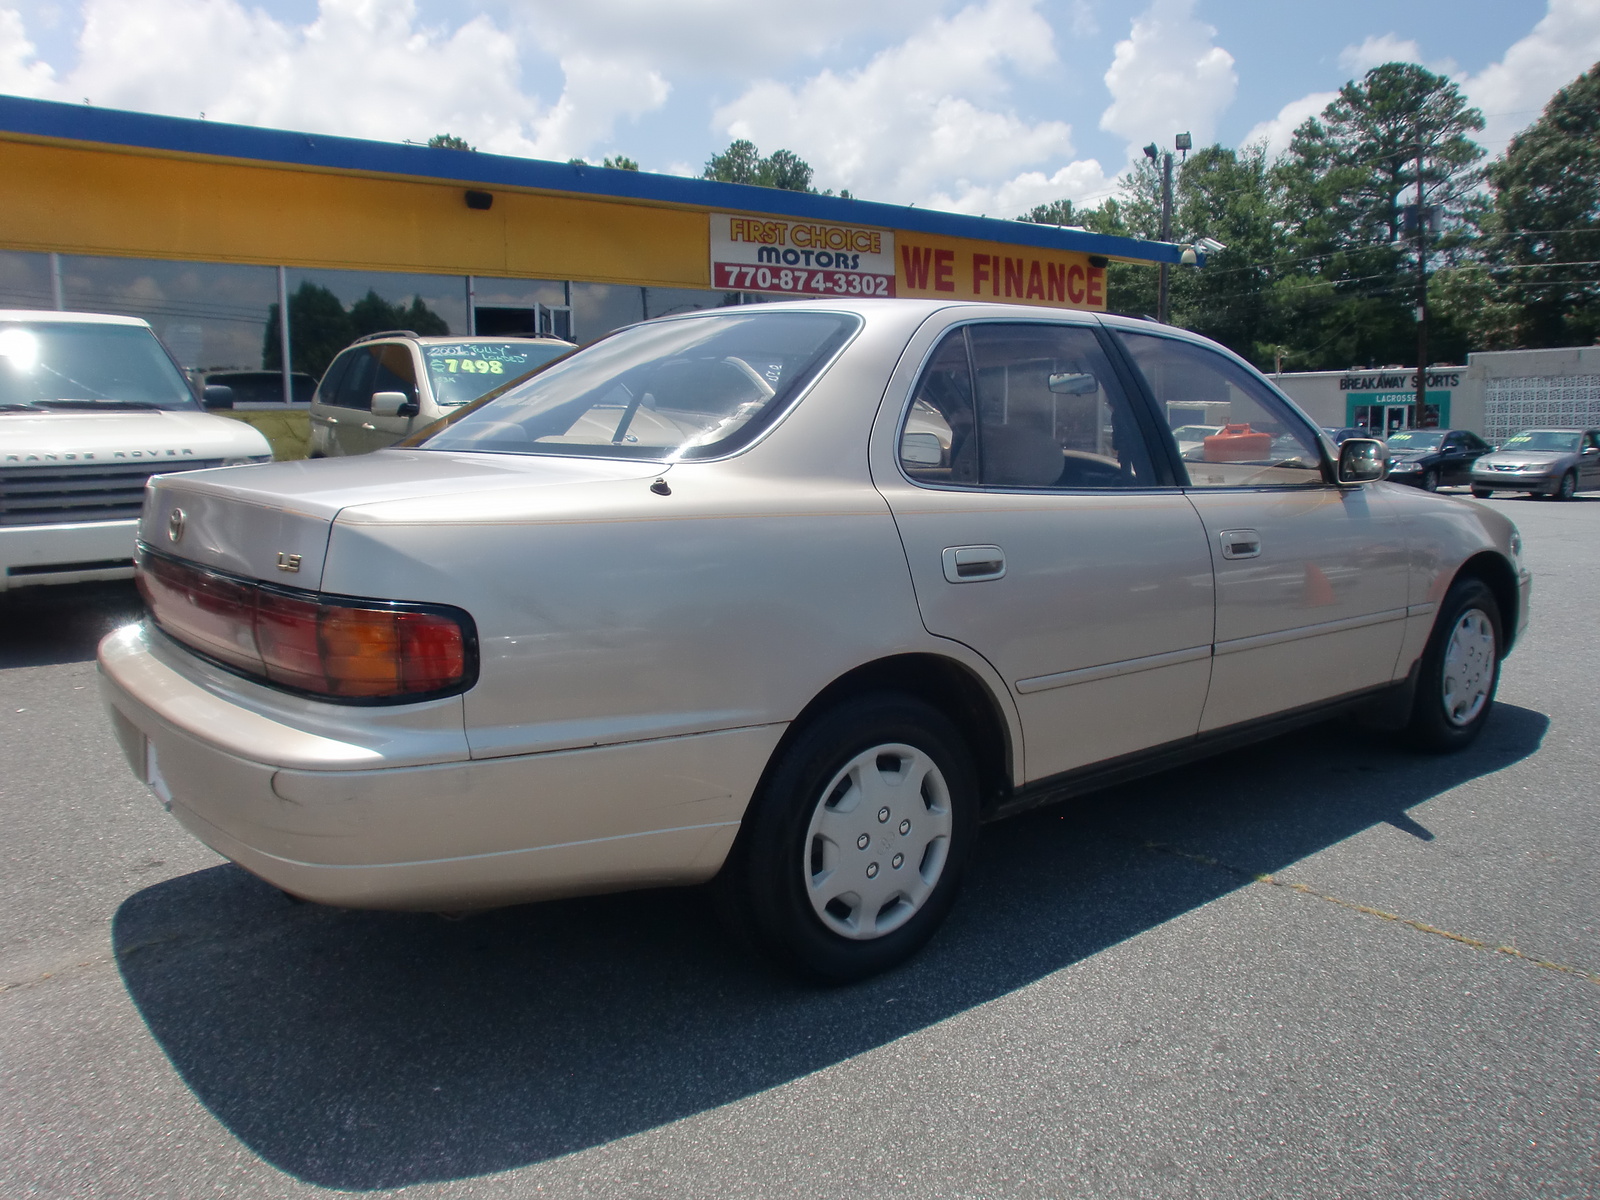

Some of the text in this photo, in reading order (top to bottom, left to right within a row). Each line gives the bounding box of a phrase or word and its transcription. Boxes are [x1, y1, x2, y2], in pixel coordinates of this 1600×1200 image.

[730, 218, 882, 254] FIRST CHOICE
[757, 245, 860, 270] MOTORS
[724, 265, 889, 297] 770-874-3302
[901, 243, 1103, 306] WE FINANCE
[1340, 374, 1459, 390] BREAKAWAY SORTS
[1376, 394, 1417, 403] LACROSSE
[6, 449, 194, 461] RANGE ROVER
[277, 551, 302, 573] LE
